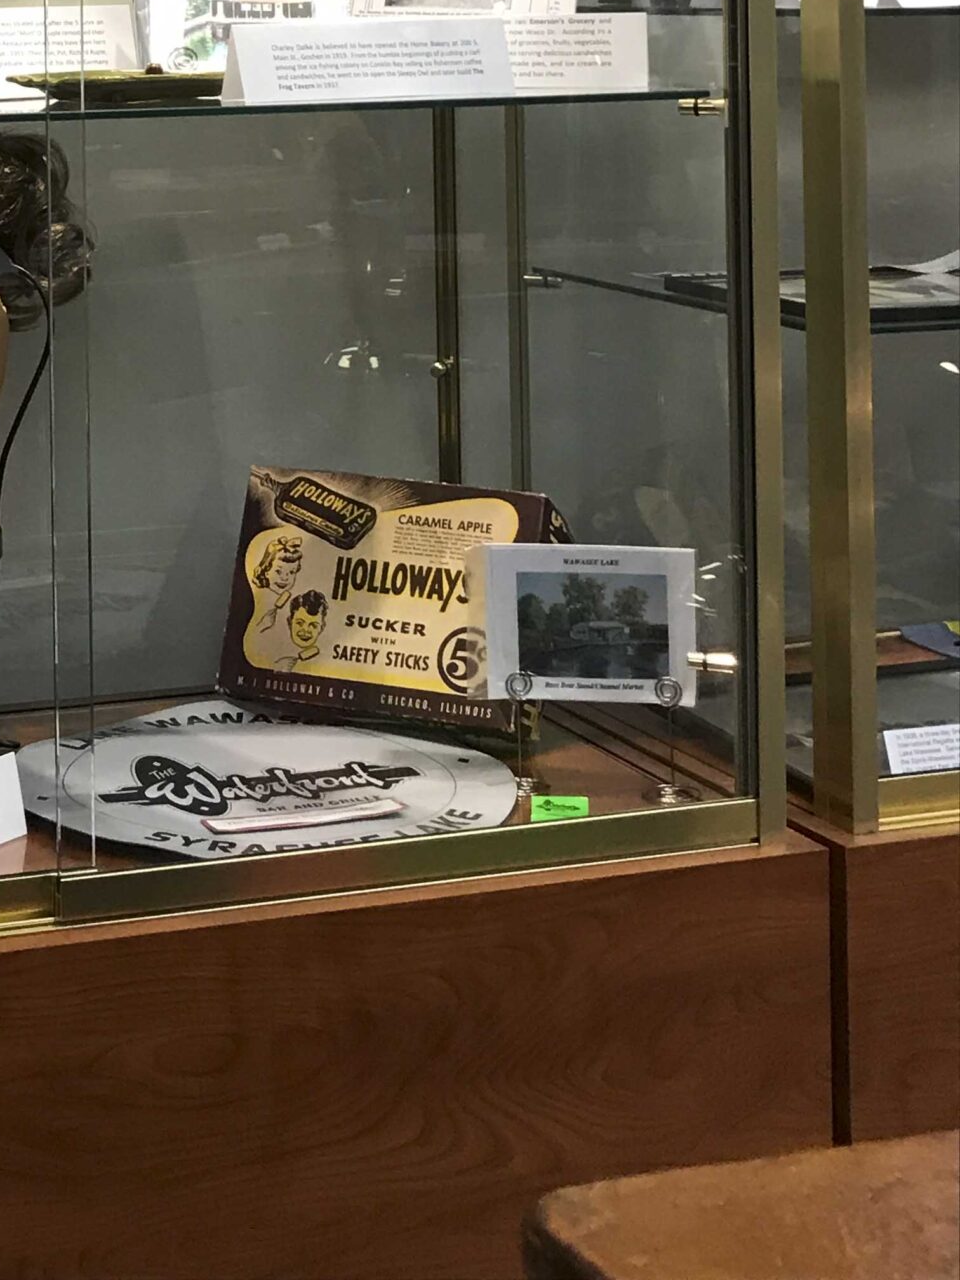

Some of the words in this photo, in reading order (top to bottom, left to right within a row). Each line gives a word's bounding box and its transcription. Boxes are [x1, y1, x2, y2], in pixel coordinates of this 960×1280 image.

[568, 17, 595, 26] Grocery
[289, 481, 371, 524] HOLLOWAY'S
[398, 514, 453, 531] CARAMEL
[458, 520, 493, 534] APPLE
[563, 558, 598, 566] WAWASEE
[345, 614, 426, 637] SUCKER
[371, 637, 396, 646] WITH
[332, 644, 379, 665] SAFETY
[385, 651, 430, 671] STICKS
[265, 679, 321, 696] HOLLOWAY
[328, 688, 334, 698] &
[380, 694, 432, 712] CHICAGO,
[440, 702, 492, 718] ILLINOIS
[149, 767, 176, 781] THE
[144, 763, 384, 806] Waterfront
[256, 805, 286, 813] BAR
[294, 802, 324, 810] AND
[328, 795, 380, 806] GRILLE
